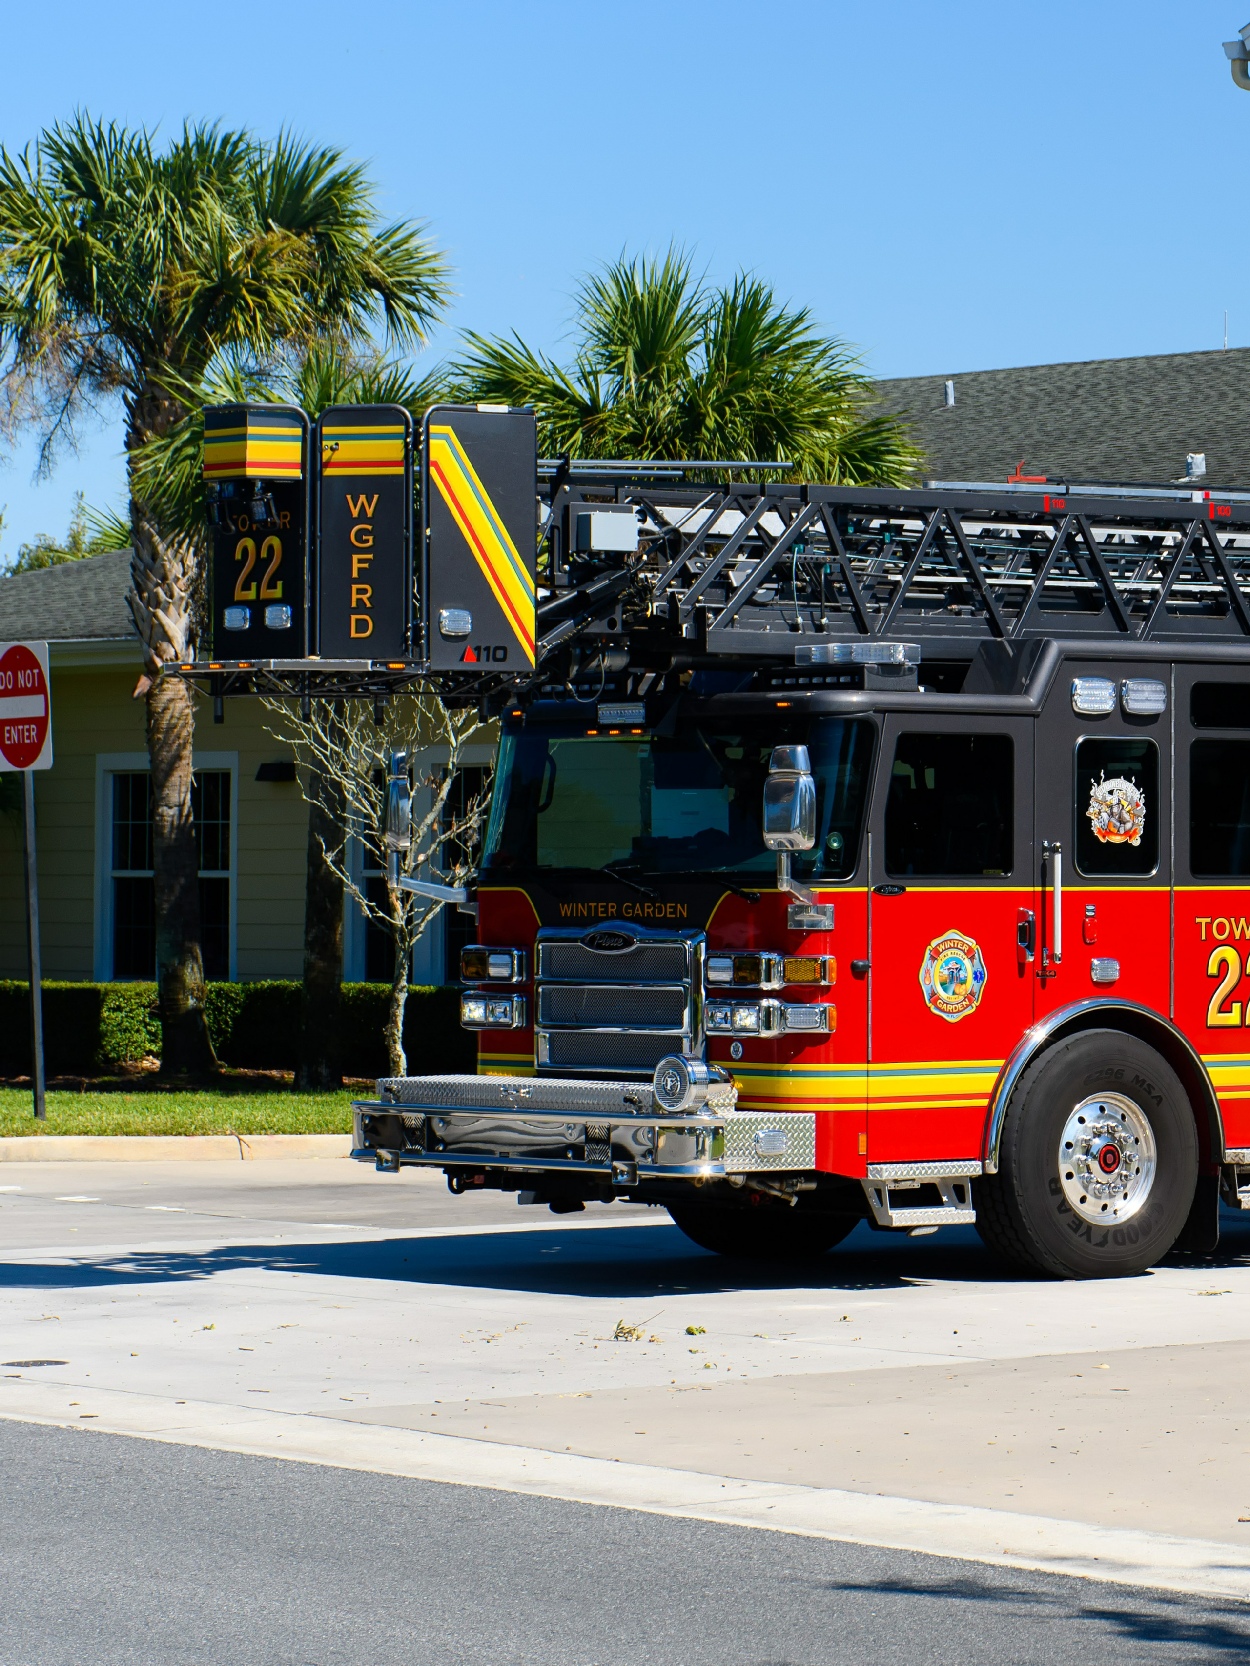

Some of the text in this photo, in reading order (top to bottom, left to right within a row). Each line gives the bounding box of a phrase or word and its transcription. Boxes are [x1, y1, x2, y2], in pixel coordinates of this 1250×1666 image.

[234, 535, 284, 601] 22
[474, 645, 508, 663] 110
[0, 669, 39, 690] DO NOT
[5, 724, 38, 744] ENTER
[559, 902, 688, 918] WINTER GARDEN
[936, 940, 969, 953] WINTER
[936, 998, 970, 1013] GARDEN
